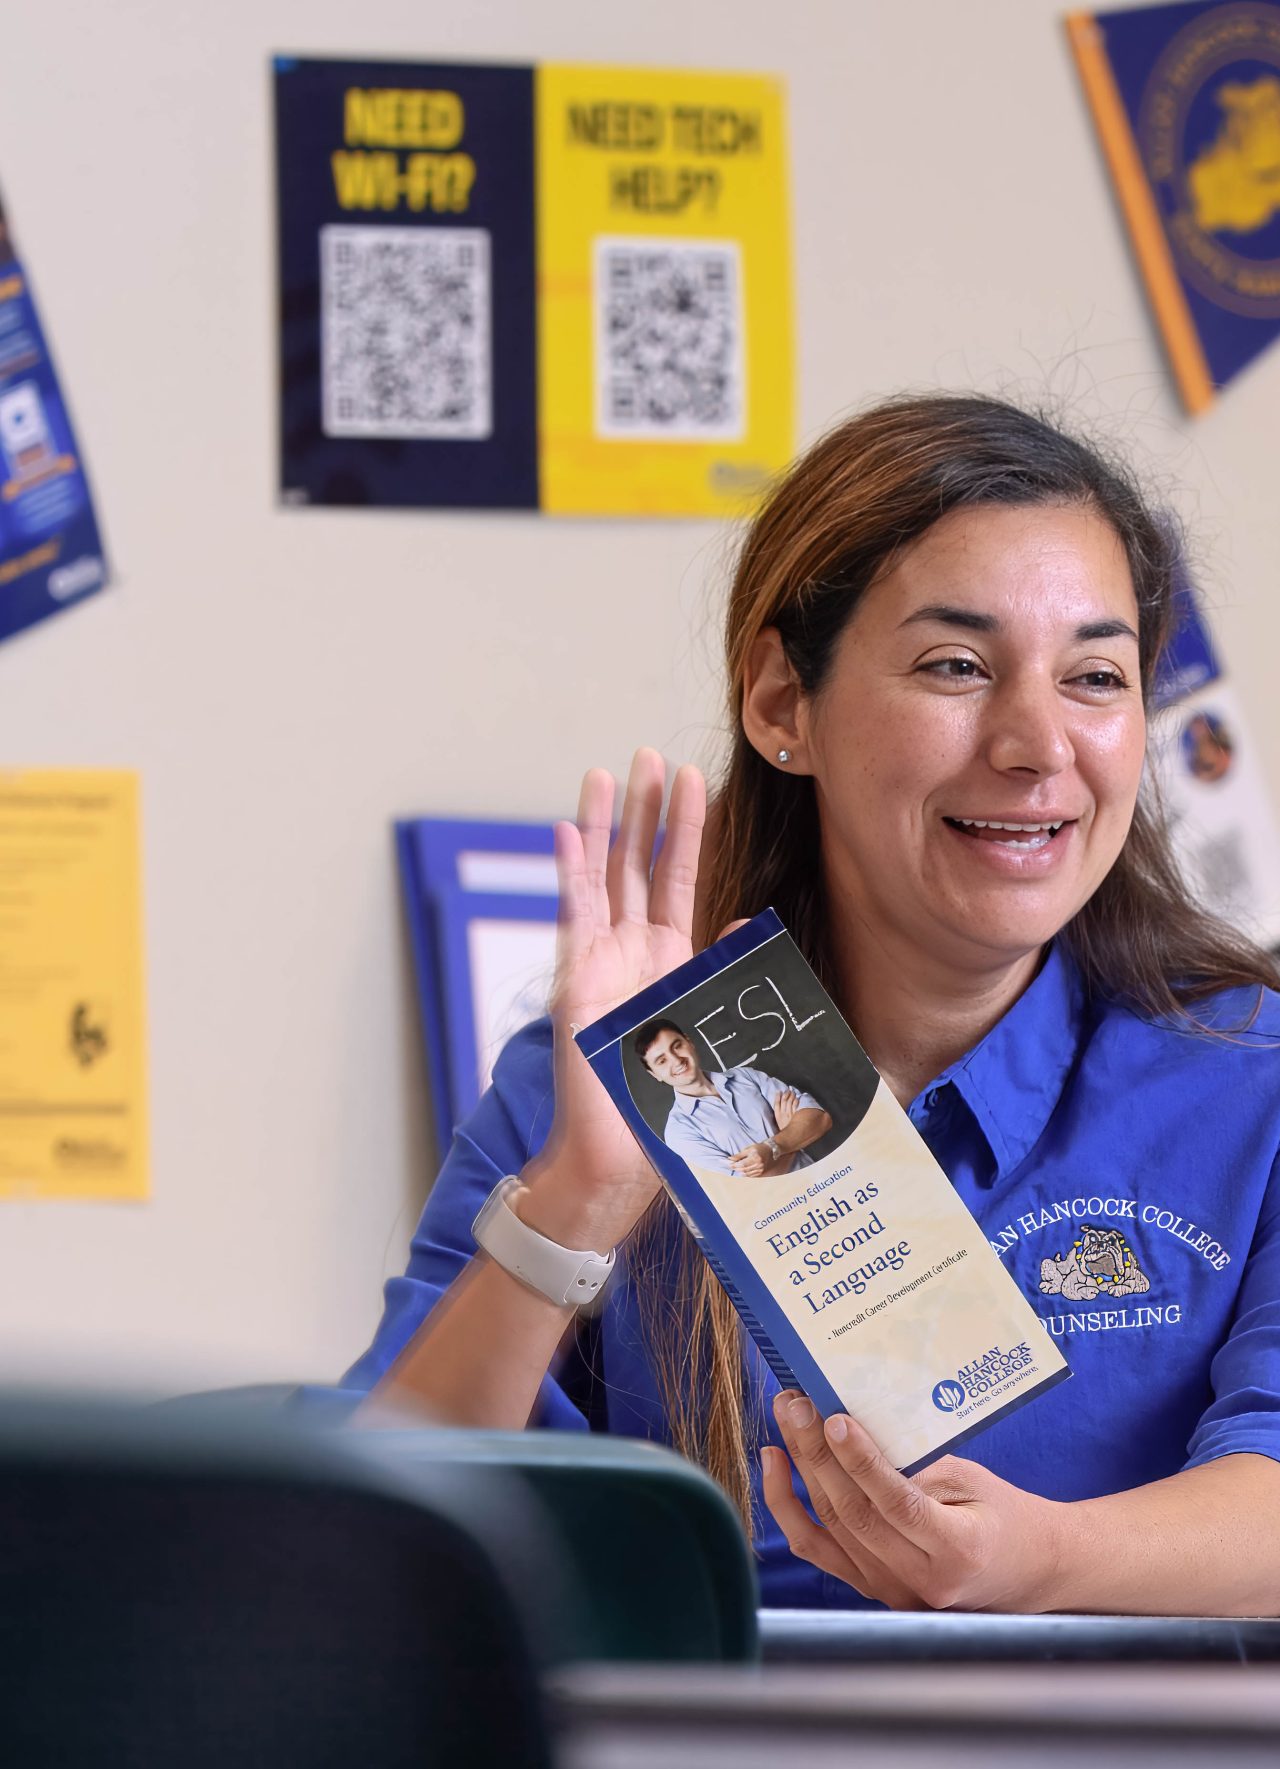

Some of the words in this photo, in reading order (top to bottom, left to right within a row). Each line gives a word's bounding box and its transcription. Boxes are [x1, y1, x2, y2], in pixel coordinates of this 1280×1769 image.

[344, 87, 464, 149] NEED
[566, 101, 664, 151] NEED
[671, 103, 764, 157] TECH
[331, 149, 476, 213] WI-FI?
[608, 164, 721, 217] HELP?
[694, 976, 826, 1073] ESL
[754, 1194, 808, 1230] Community
[806, 1165, 853, 1197] Education
[765, 1197, 853, 1259] English
[854, 1182, 879, 1205] as
[789, 1270, 806, 1286] a
[803, 1211, 886, 1275] Second
[1017, 1197, 1137, 1235] HANCOCK
[1142, 1205, 1231, 1271] COLLEGE
[802, 1241, 911, 1315] Language
[832, 1313, 867, 1339] Noncredit
[864, 1301, 888, 1317] Career
[886, 1271, 933, 1304] Development
[932, 1249, 968, 1276] Certificate
[957, 1346, 1002, 1381] ALLAN
[962, 1341, 1031, 1390] HANCOCK
[968, 1353, 1033, 1398] COLLEGE
[956, 1406, 974, 1420] Start
[990, 1388, 1003, 1397] Go
